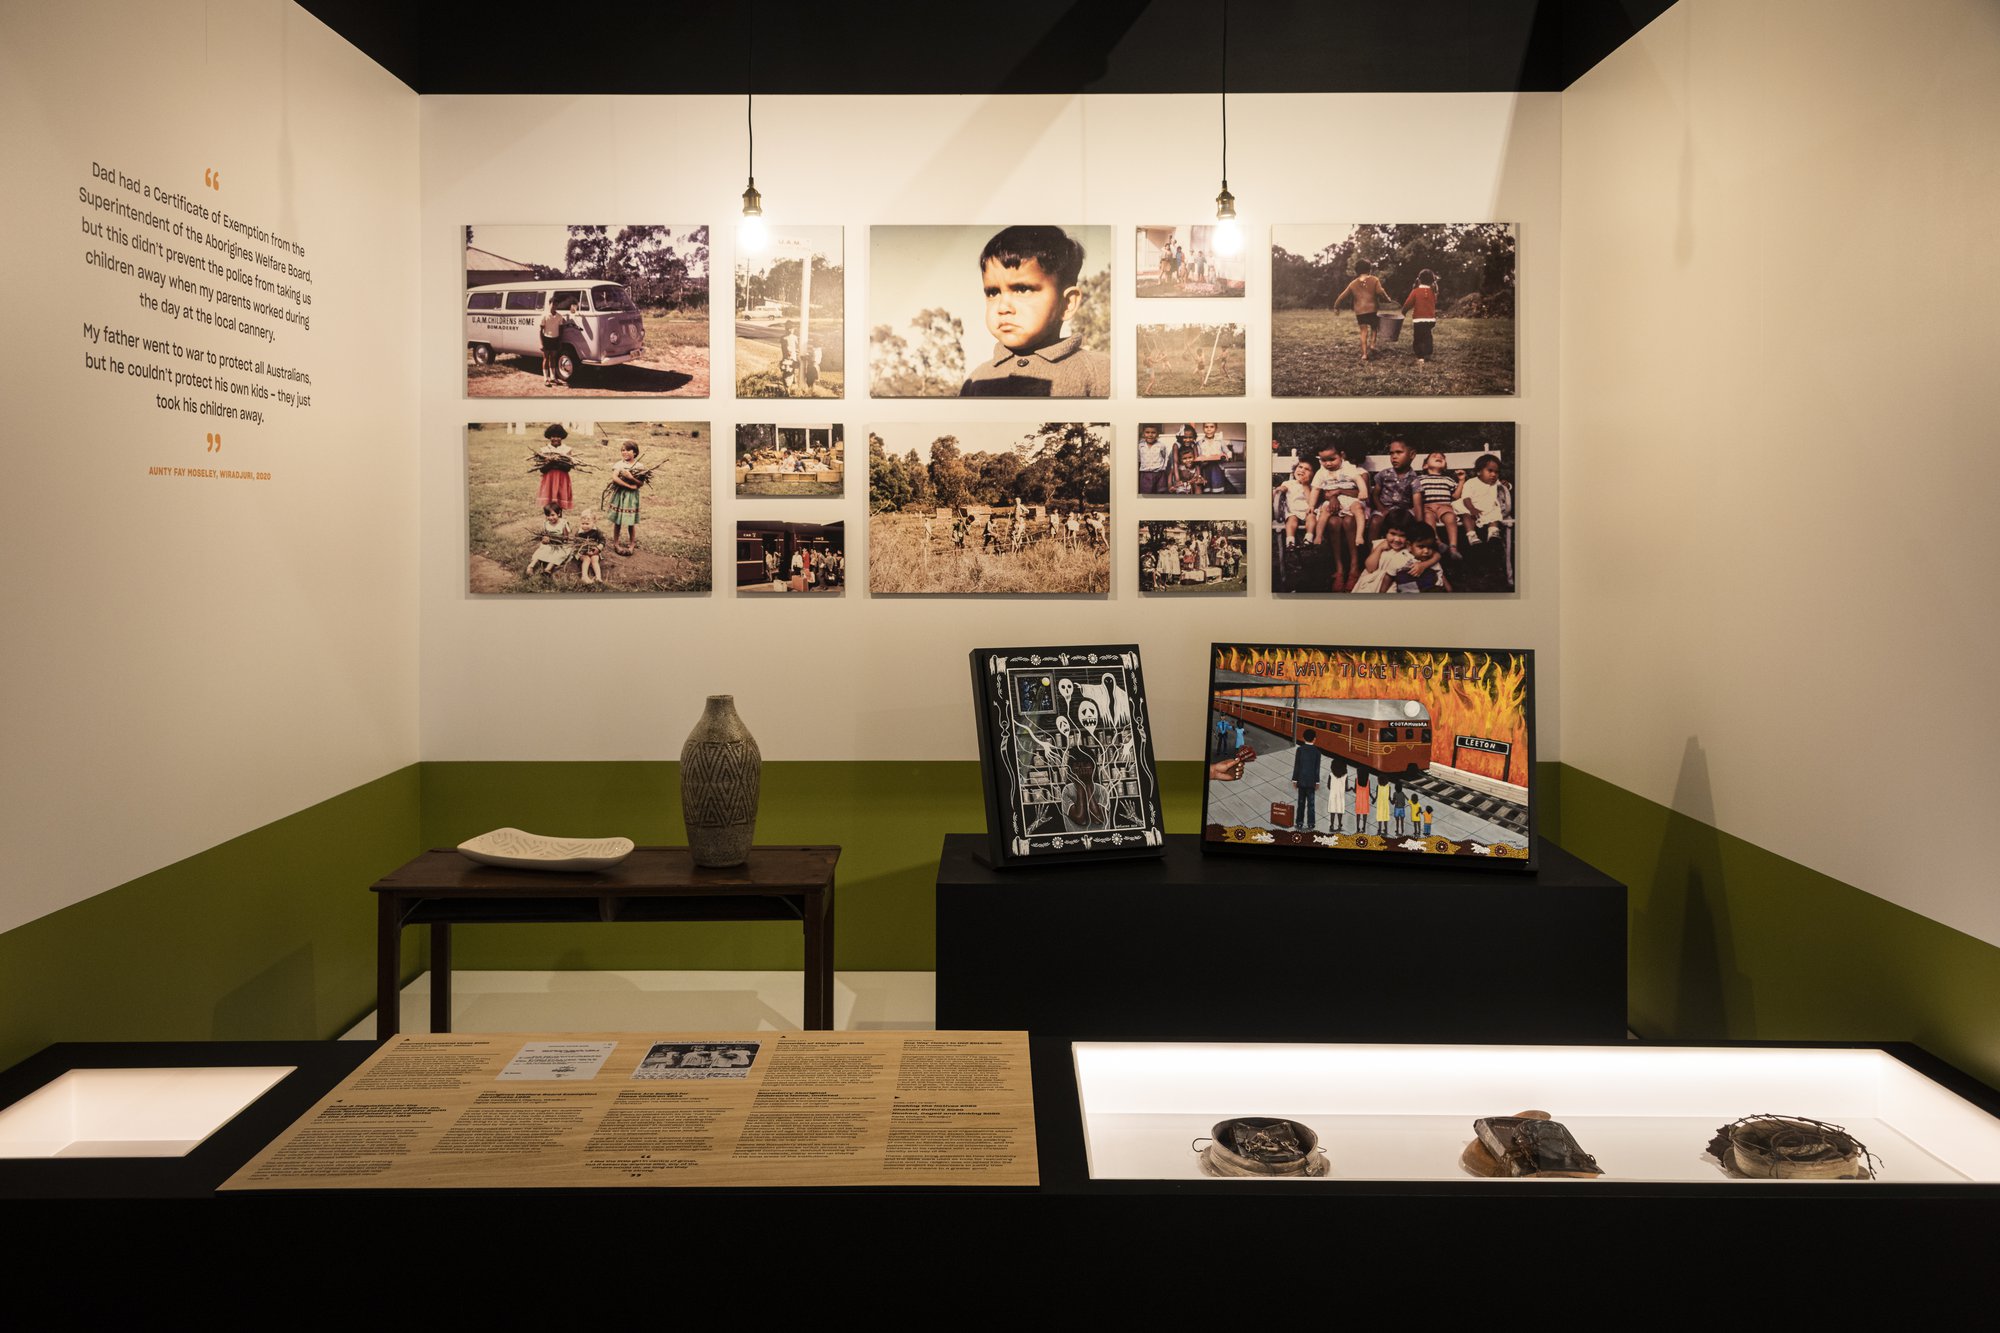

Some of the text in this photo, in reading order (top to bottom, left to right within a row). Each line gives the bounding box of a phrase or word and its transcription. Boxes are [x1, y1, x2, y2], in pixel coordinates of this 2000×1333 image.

[92, 161, 305, 257] Dad had a Certificate of Exemption from the
[79, 187, 313, 285] Superintendent of the Aborigines Welfare Board,
[82, 216, 103, 238] but
[106, 225, 129, 246] this
[166, 248, 206, 271] prevent
[208, 259, 224, 277] the
[226, 266, 253, 286] police
[255, 275, 275, 294] from
[277, 282, 301, 306] taking
[302, 293, 312, 305] us
[85, 249, 310, 331] children away when my parents worked during
[139, 293, 276, 343] the day at the local cannery.
[518, 318, 535, 326] HOME
[83, 323, 312, 386] My father went to war to protect all Australians,
[85, 352, 106, 372] but
[110, 356, 125, 375] he
[175, 371, 212, 390] protect
[215, 376, 229, 393] his
[231, 382, 249, 396] own
[251, 384, 269, 400] kids
[278, 389, 295, 407] they
[296, 392, 311, 408] just
[156, 394, 265, 425] took his children away.
[149, 467, 272, 481] AUNTY FAY MOSELEY, WIRADJURI, 2020
[1255, 661, 1482, 681] ONE WAY TICKET TO HELL
[1465, 739, 1496, 749] LEETON
